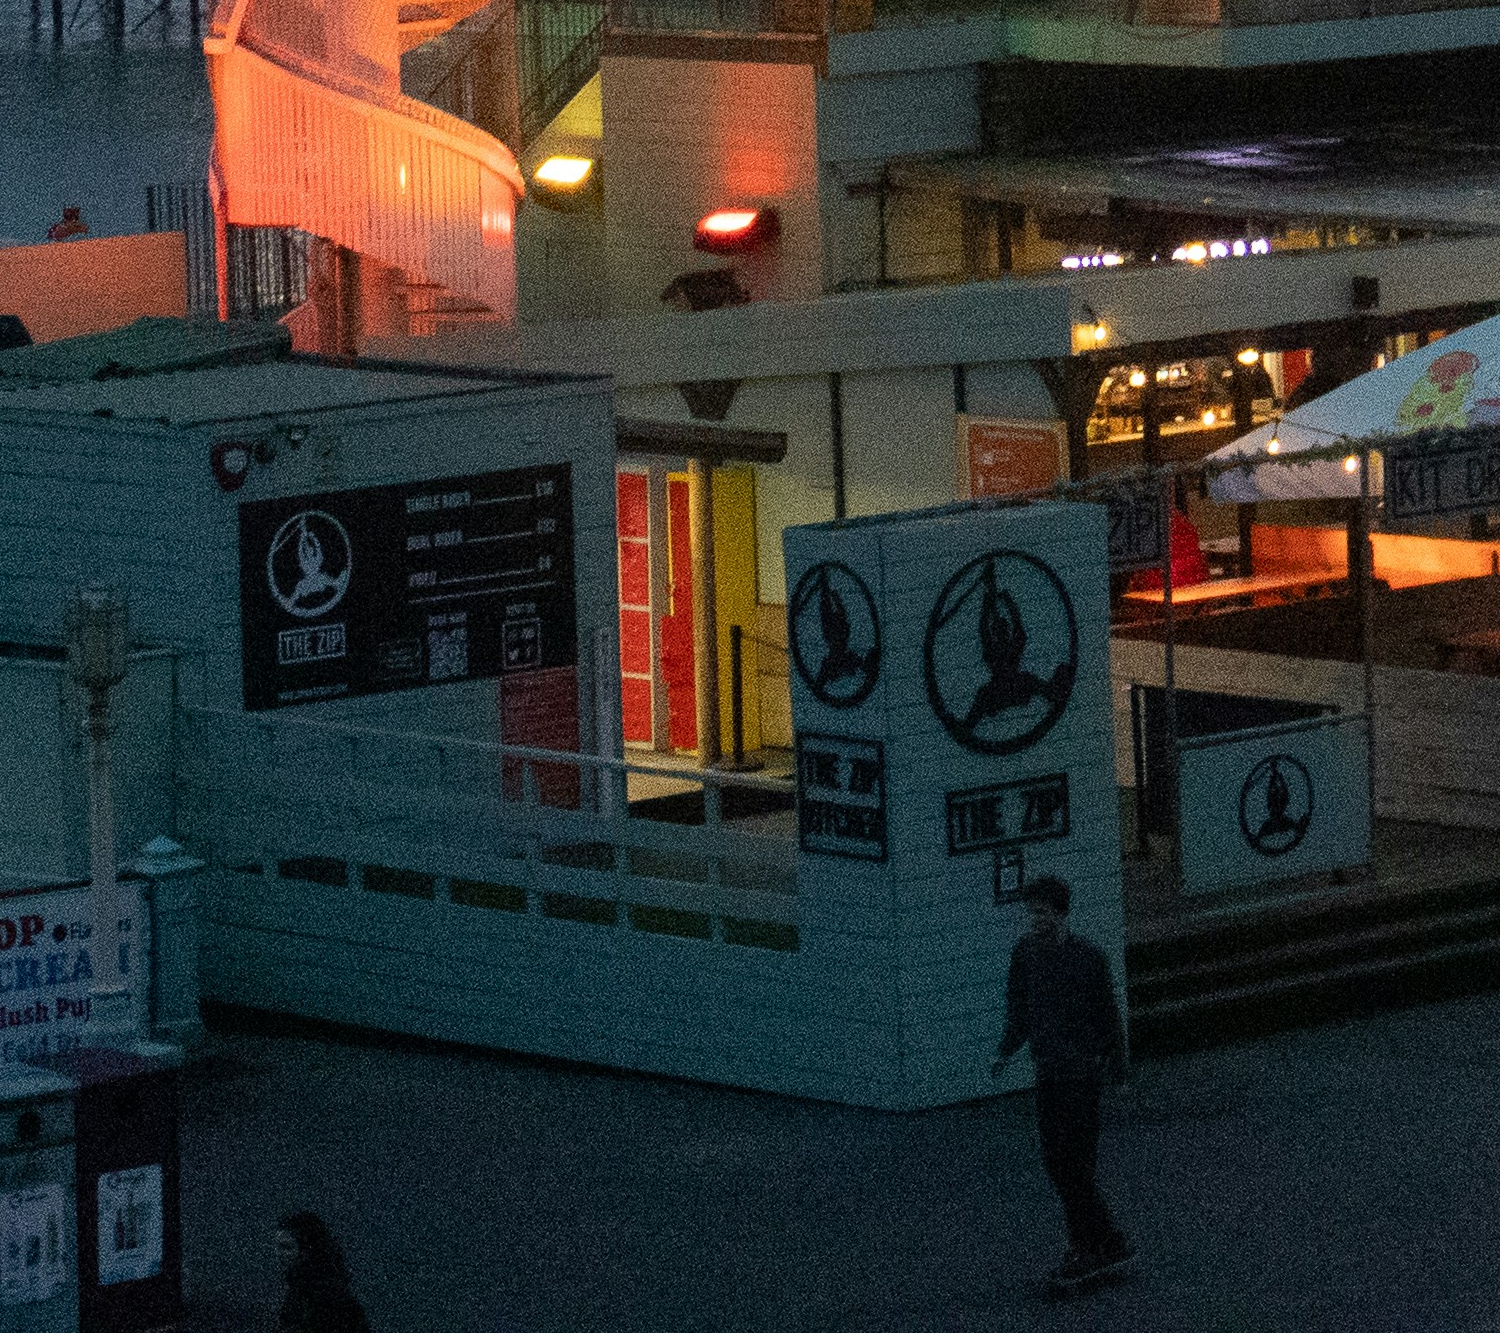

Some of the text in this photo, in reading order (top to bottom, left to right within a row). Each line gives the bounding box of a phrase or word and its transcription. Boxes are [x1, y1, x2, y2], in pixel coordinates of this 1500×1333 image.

[1396, 459, 1447, 511] KIT
[283, 630, 342, 660] THE ZIP
[952, 788, 1064, 843] THE ZIP
